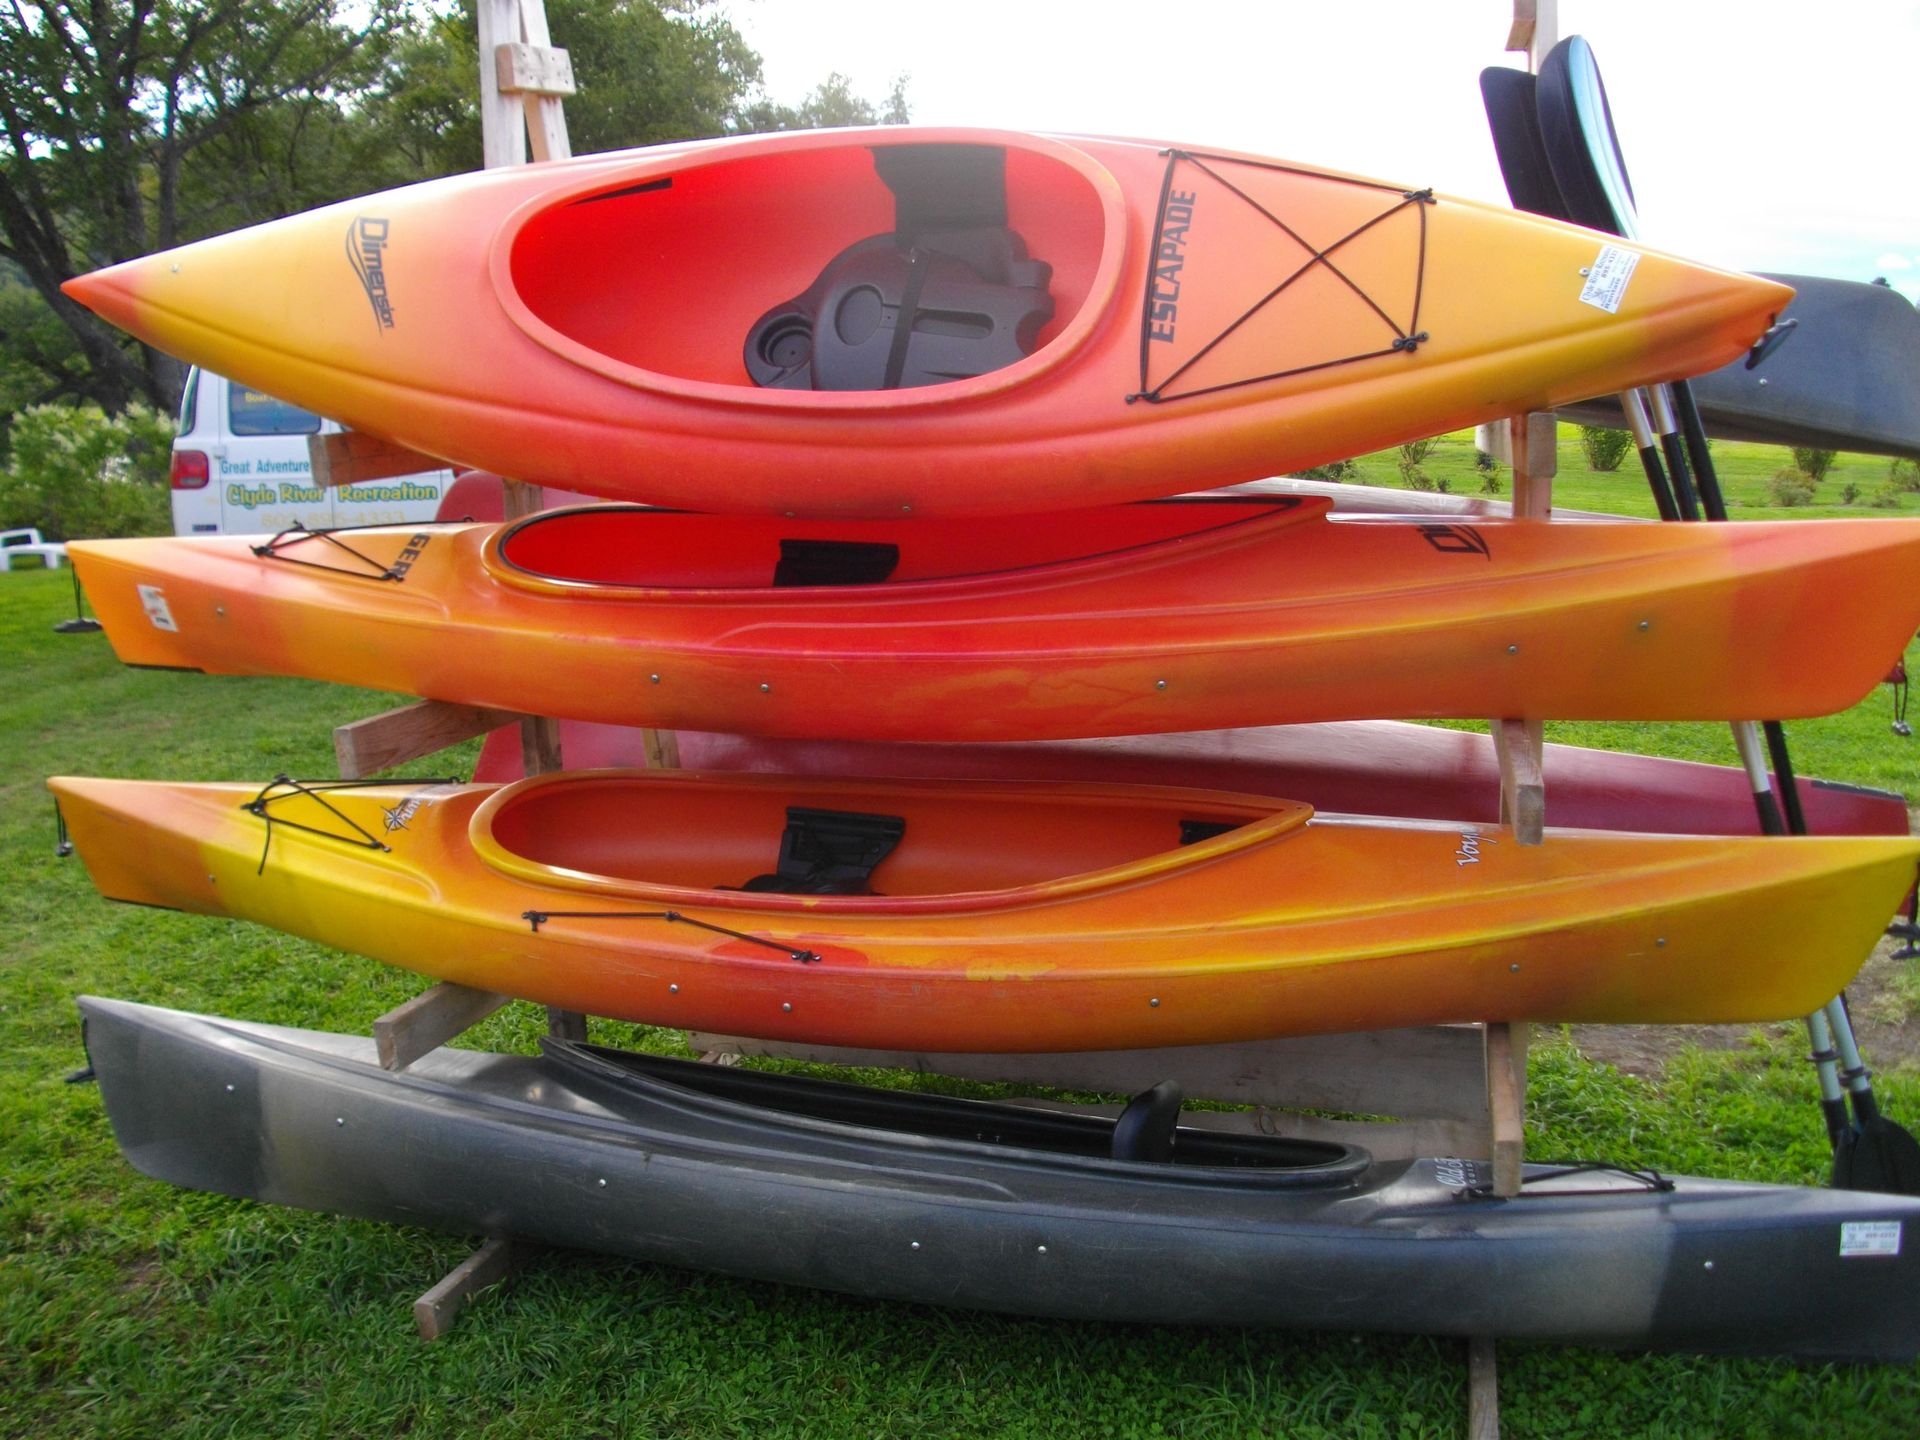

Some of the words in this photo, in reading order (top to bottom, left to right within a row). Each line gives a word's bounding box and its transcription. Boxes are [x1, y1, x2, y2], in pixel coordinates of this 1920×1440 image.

[359, 217, 395, 328] Dimension
[1149, 190, 1196, 343] ESCAPADE
[221, 460, 250, 474] Great
[227, 483, 276, 510] Clyde
[278, 483, 326, 503] River
[337, 481, 438, 502] Recreation
[391, 533, 431, 577] GER
[1456, 830, 1497, 866] Voy
